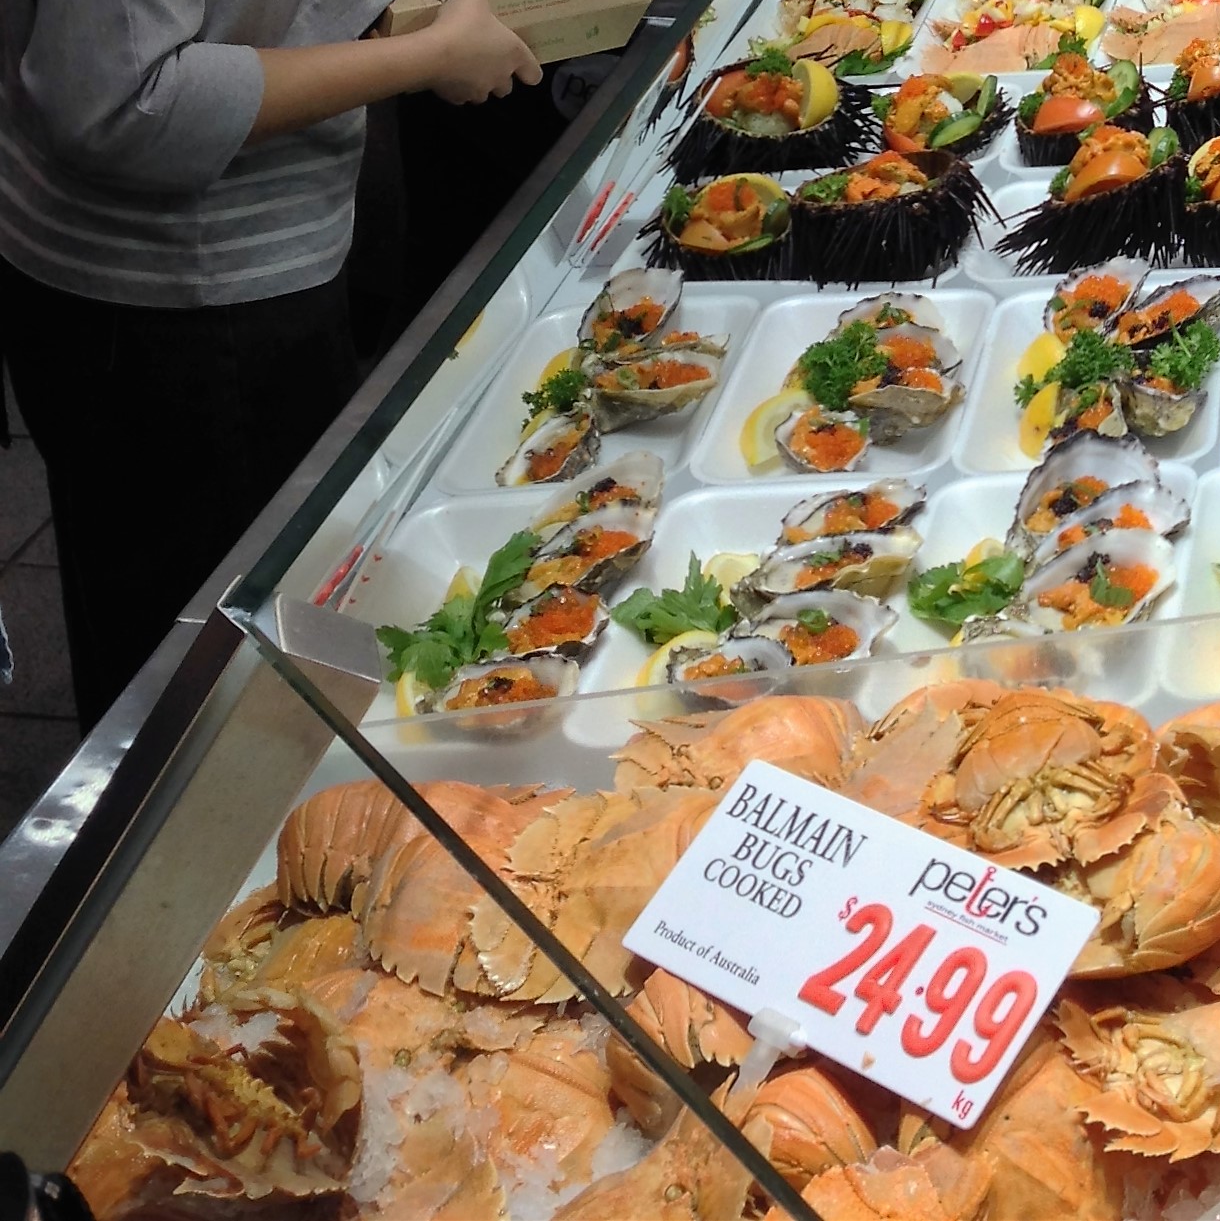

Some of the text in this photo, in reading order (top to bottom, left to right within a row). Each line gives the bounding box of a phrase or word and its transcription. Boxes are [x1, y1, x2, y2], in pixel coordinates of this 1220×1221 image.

[726, 783, 869, 869] BALMAIN
[703, 858, 802, 919] COOKED
[730, 832, 814, 887] BUGS
[908, 858, 1047, 937] peter's
[927, 900, 1009, 943] sydney fish market
[653, 920, 761, 986] Product of Australia
[951, 1090, 975, 1120] kg
